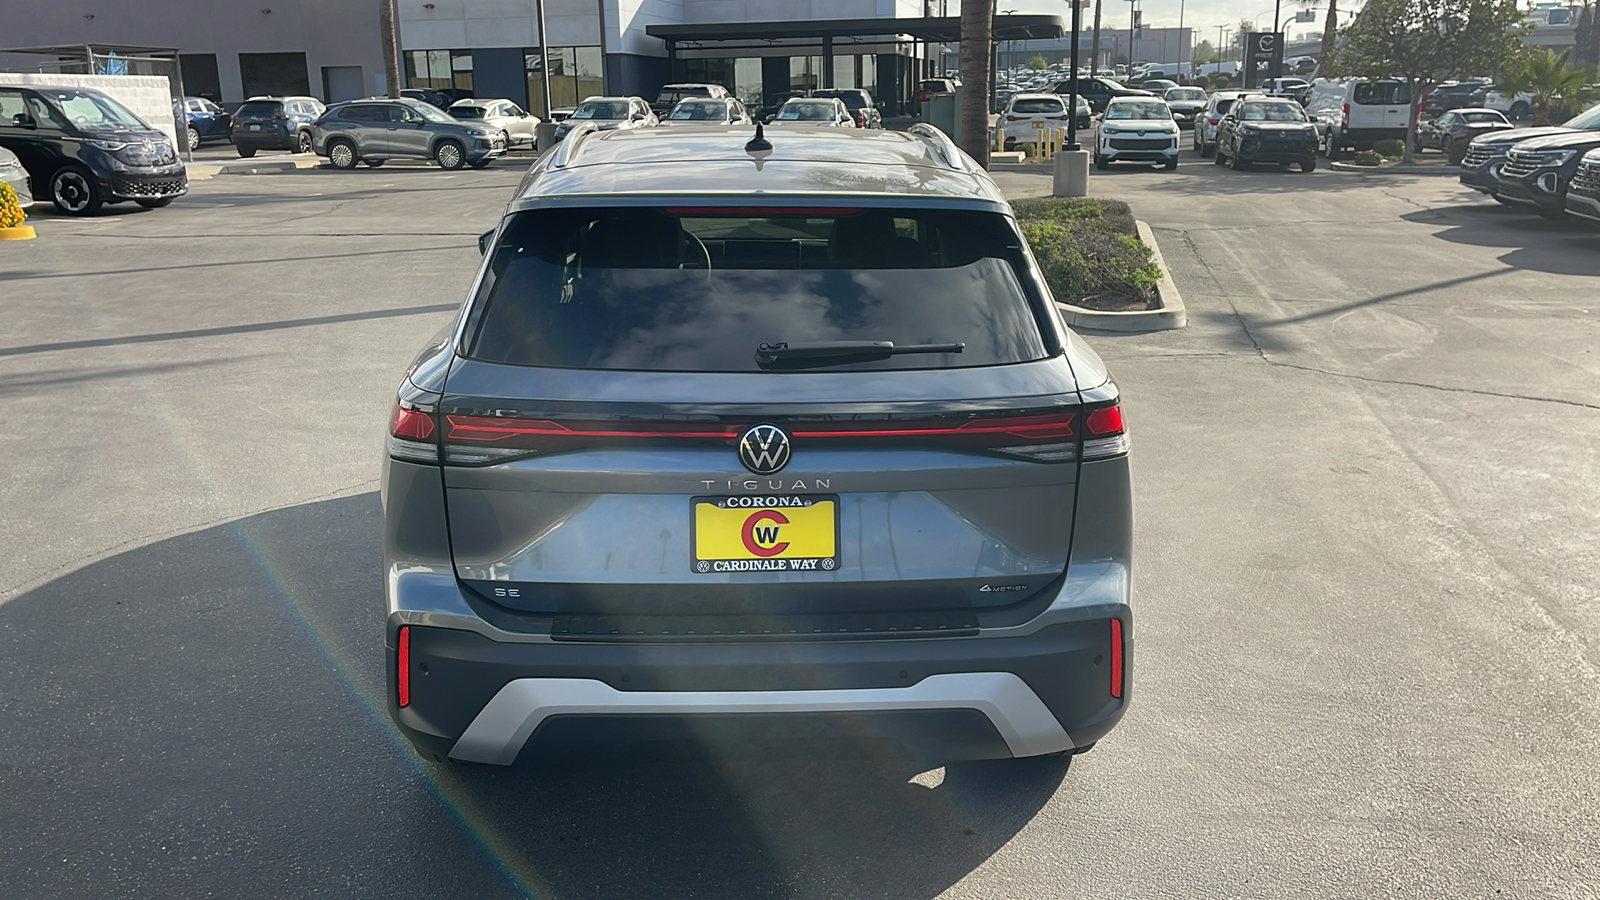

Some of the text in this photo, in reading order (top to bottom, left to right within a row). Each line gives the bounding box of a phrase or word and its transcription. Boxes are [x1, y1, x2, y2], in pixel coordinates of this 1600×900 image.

[701, 479, 831, 490] TIGUAN
[726, 496, 803, 507] CORONA
[713, 559, 819, 572] CARDINALE WAY
[494, 588, 520, 597] SE
[979, 584, 1028, 593] 4MOTION
